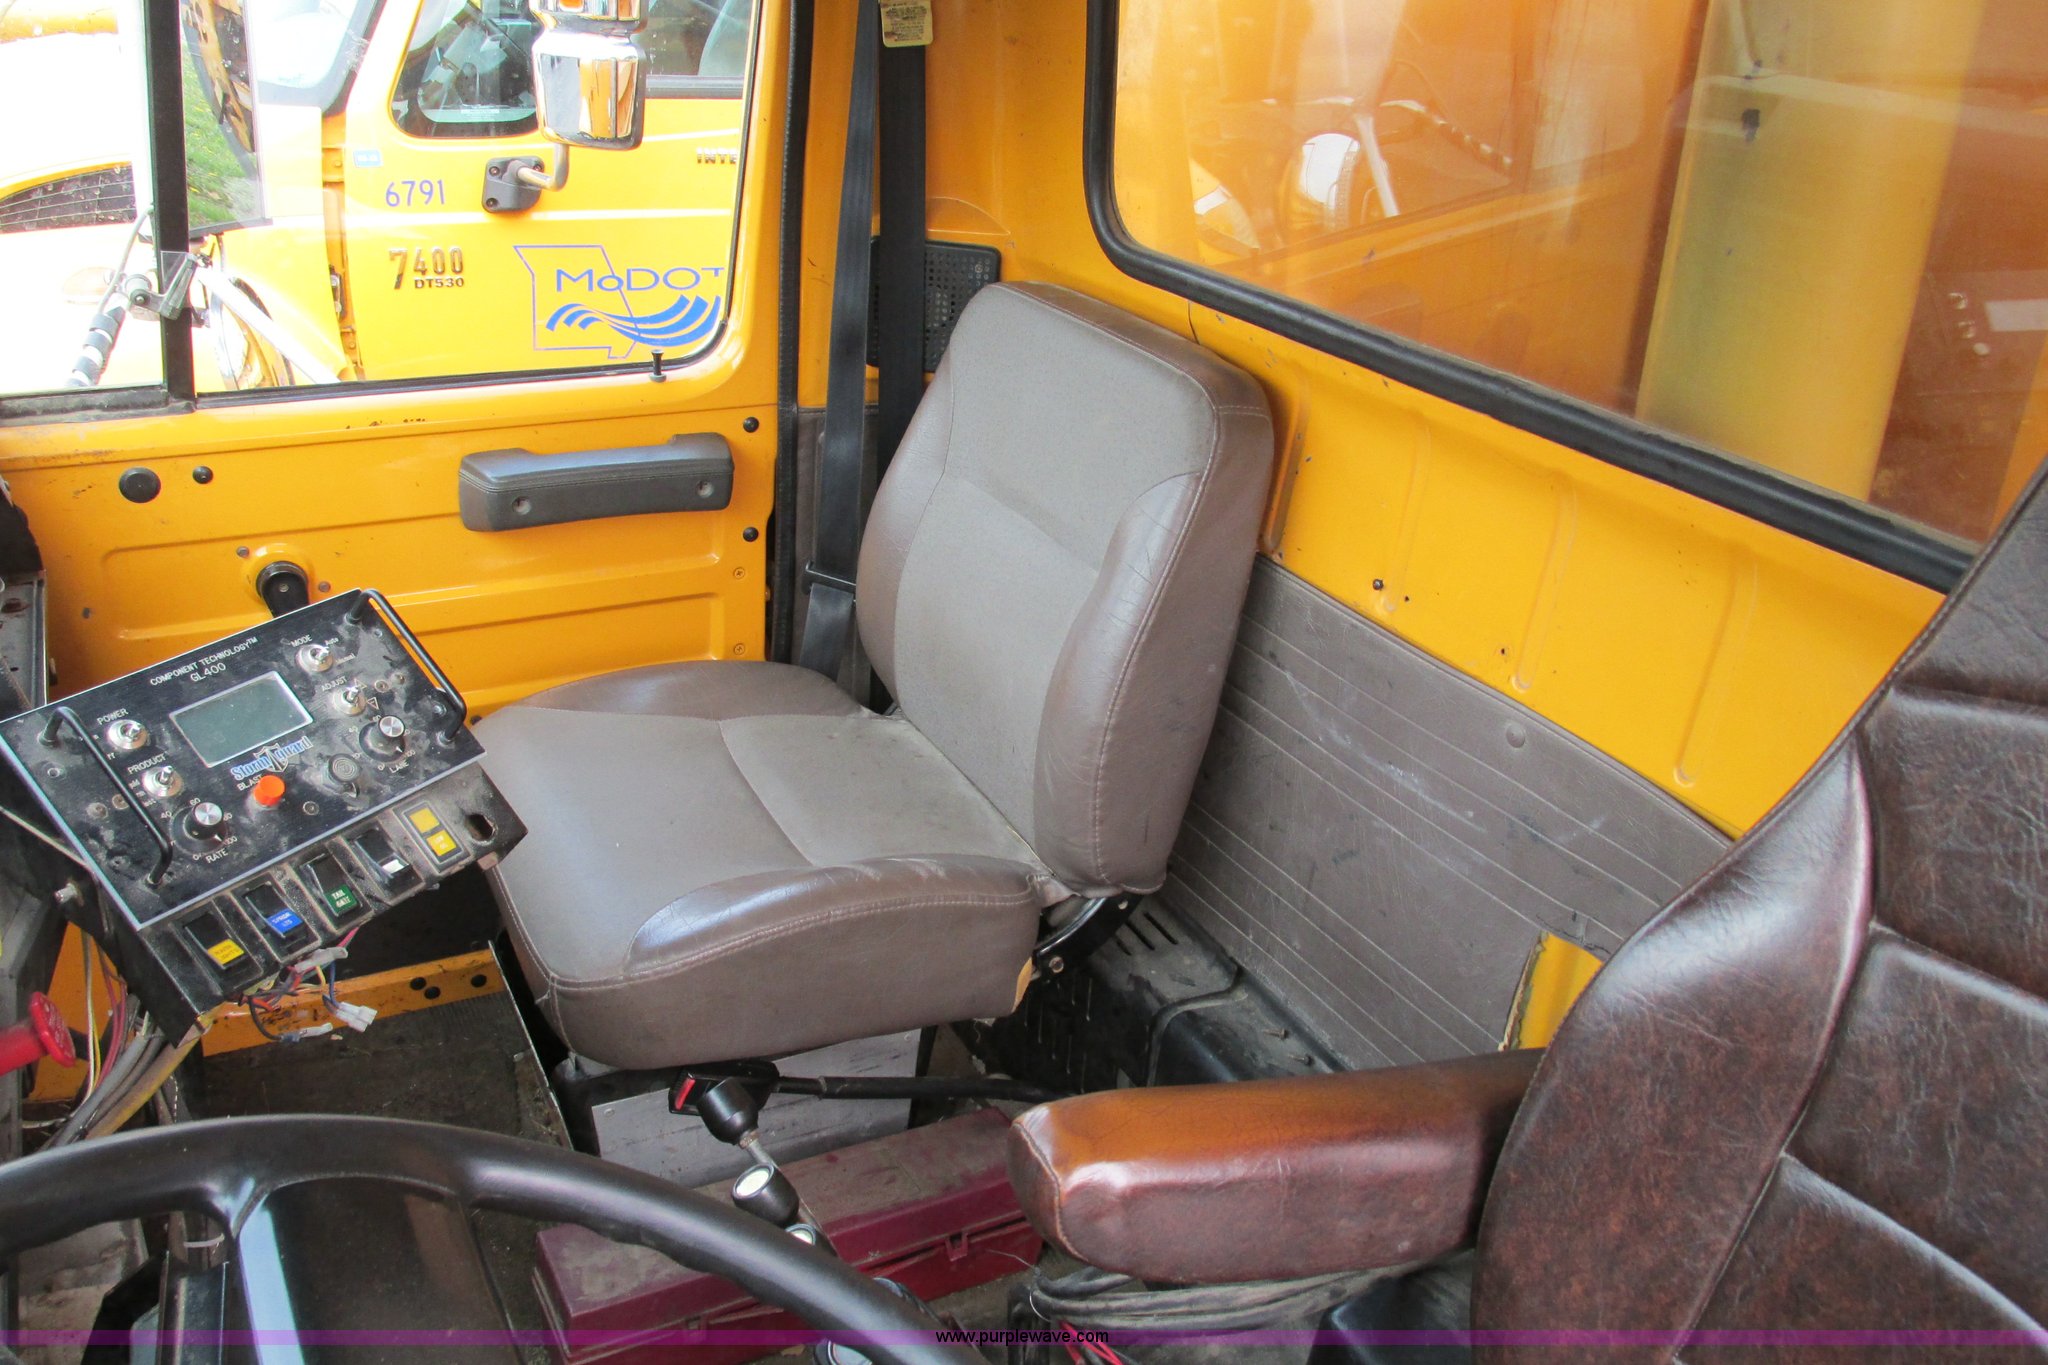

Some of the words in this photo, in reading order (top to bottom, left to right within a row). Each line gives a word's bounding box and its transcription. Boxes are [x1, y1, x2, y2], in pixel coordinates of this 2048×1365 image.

[385, 179, 445, 207] 6791
[389, 247, 464, 290] 7400
[414, 277, 465, 289] DT530
[556, 267, 724, 292] MoDOT
[291, 634, 312, 647] MODE
[150, 661, 198, 686] COMPONENT
[321, 675, 348, 692] ADJUST
[97, 708, 129, 725] POWER
[127, 752, 167, 775] PRODUCT
[236, 774, 262, 791] BLAST
[205, 848, 229, 863] RATE
